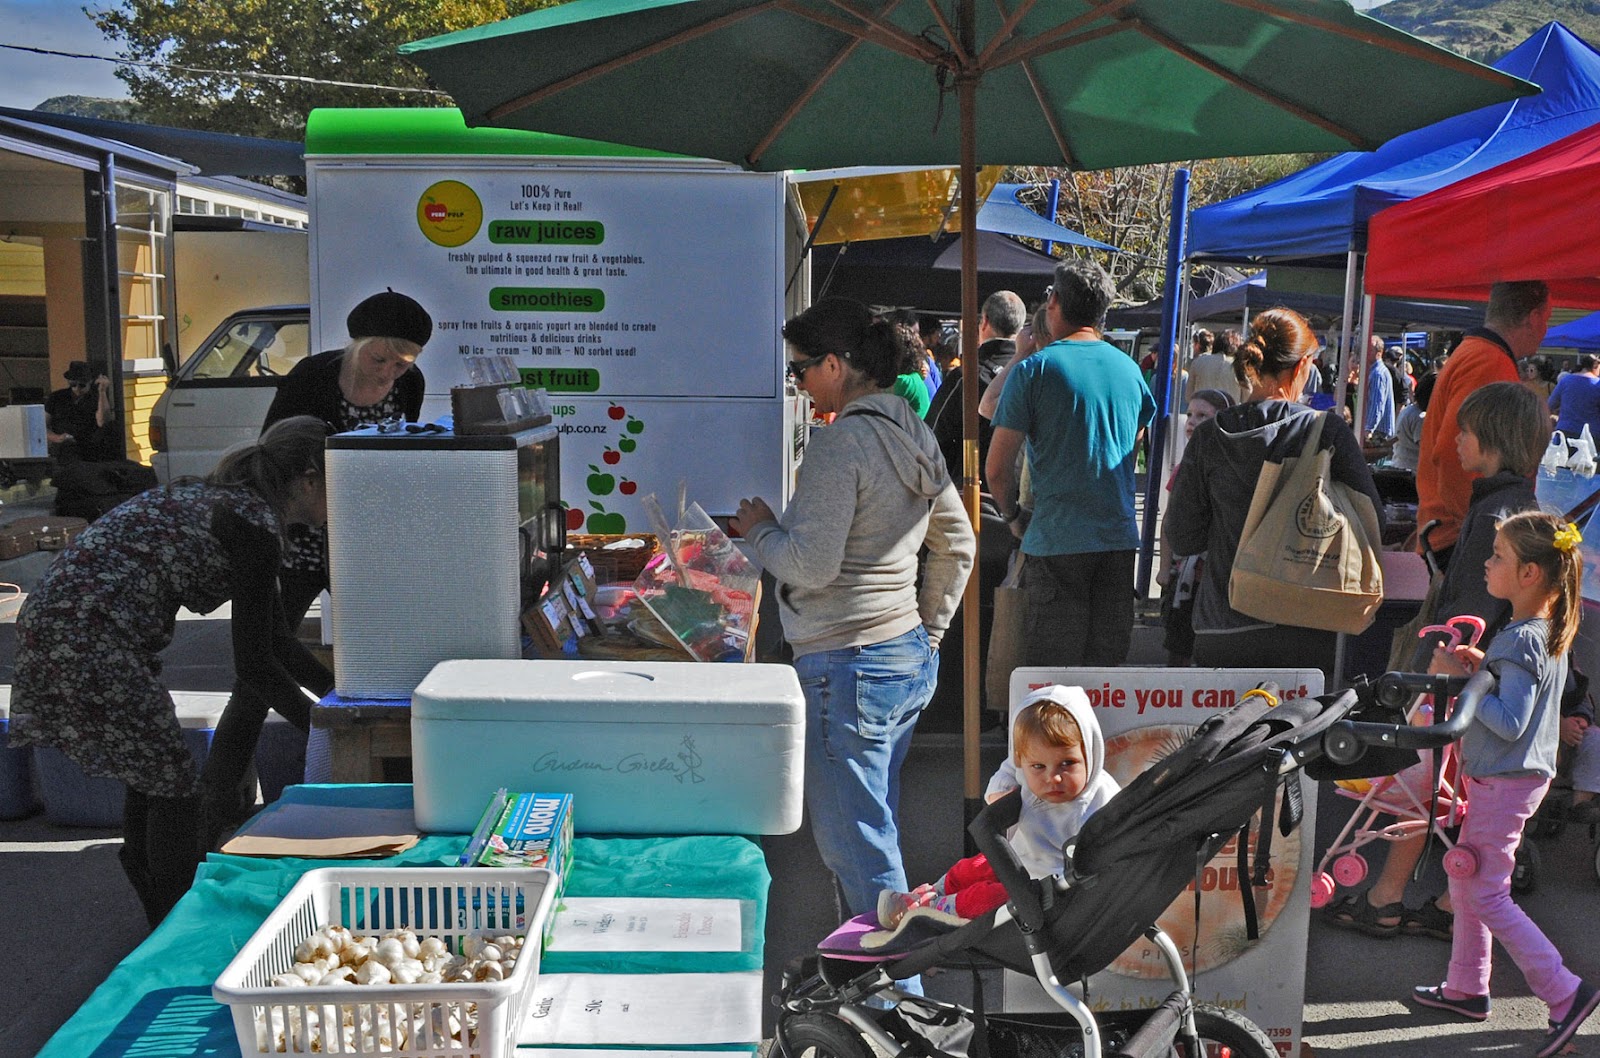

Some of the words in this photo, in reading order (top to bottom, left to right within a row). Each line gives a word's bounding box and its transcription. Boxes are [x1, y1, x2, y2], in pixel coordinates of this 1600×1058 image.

[521, 185, 550, 198] 100%
[554, 188, 571, 198] Pure
[511, 201, 529, 210] Let's
[533, 201, 551, 212] Keep
[554, 201, 560, 210] it
[563, 201, 582, 211] Real!
[496, 225, 530, 239] raw
[537, 223, 596, 242] juices
[449, 252, 474, 263] freshly
[478, 253, 503, 263] pulped
[507, 254, 512, 262] &
[516, 253, 551, 264] squeezed
[555, 255, 569, 263] raw
[572, 254, 589, 263] fruit
[592, 254, 598, 263] &
[602, 254, 645, 265] vegetables.
[466, 266, 478, 274] the
[481, 266, 512, 275] ultimate
[515, 266, 522, 275] in
[526, 266, 543, 276] good
[547, 267, 570, 275] health
[574, 267, 579, 276] &
[583, 267, 602, 277] great
[606, 267, 627, 276] taste.
[501, 292, 593, 306] smoothies
[438, 322, 459, 330] spray
[463, 321, 478, 330] free
[481, 321, 501, 330] fruits
[506, 321, 511, 330] &
[515, 322, 542, 332] organic
[547, 322, 571, 332] yogurt
[574, 323, 586, 331] are
[589, 322, 618, 331] blended
[621, 323, 629, 331] to
[632, 323, 656, 331] create
[490, 334, 527, 343] nutritious
[531, 334, 536, 342] &
[540, 334, 574, 343] delicious
[577, 334, 601, 343] drinks
[459, 346, 470, 355] NO
[473, 346, 484, 355] ice
[497, 347, 520, 355] cream
[532, 346, 542, 355] NO
[546, 346, 562, 355] milk
[574, 347, 585, 355] NO
[588, 347, 613, 356] sorbet
[616, 347, 636, 356] used!
[520, 370, 543, 385] ust
[549, 369, 589, 386] fruit
[552, 405, 576, 417] ups
[557, 423, 607, 435] ulp.co.nz
[1090, 682, 1126, 708] pie
[1135, 689, 1183, 714] you
[1192, 689, 1236, 708] can
[523, 798, 561, 835] mono
[1142, 945, 1189, 959] PIS
[531, 997, 554, 1019] Garlic
